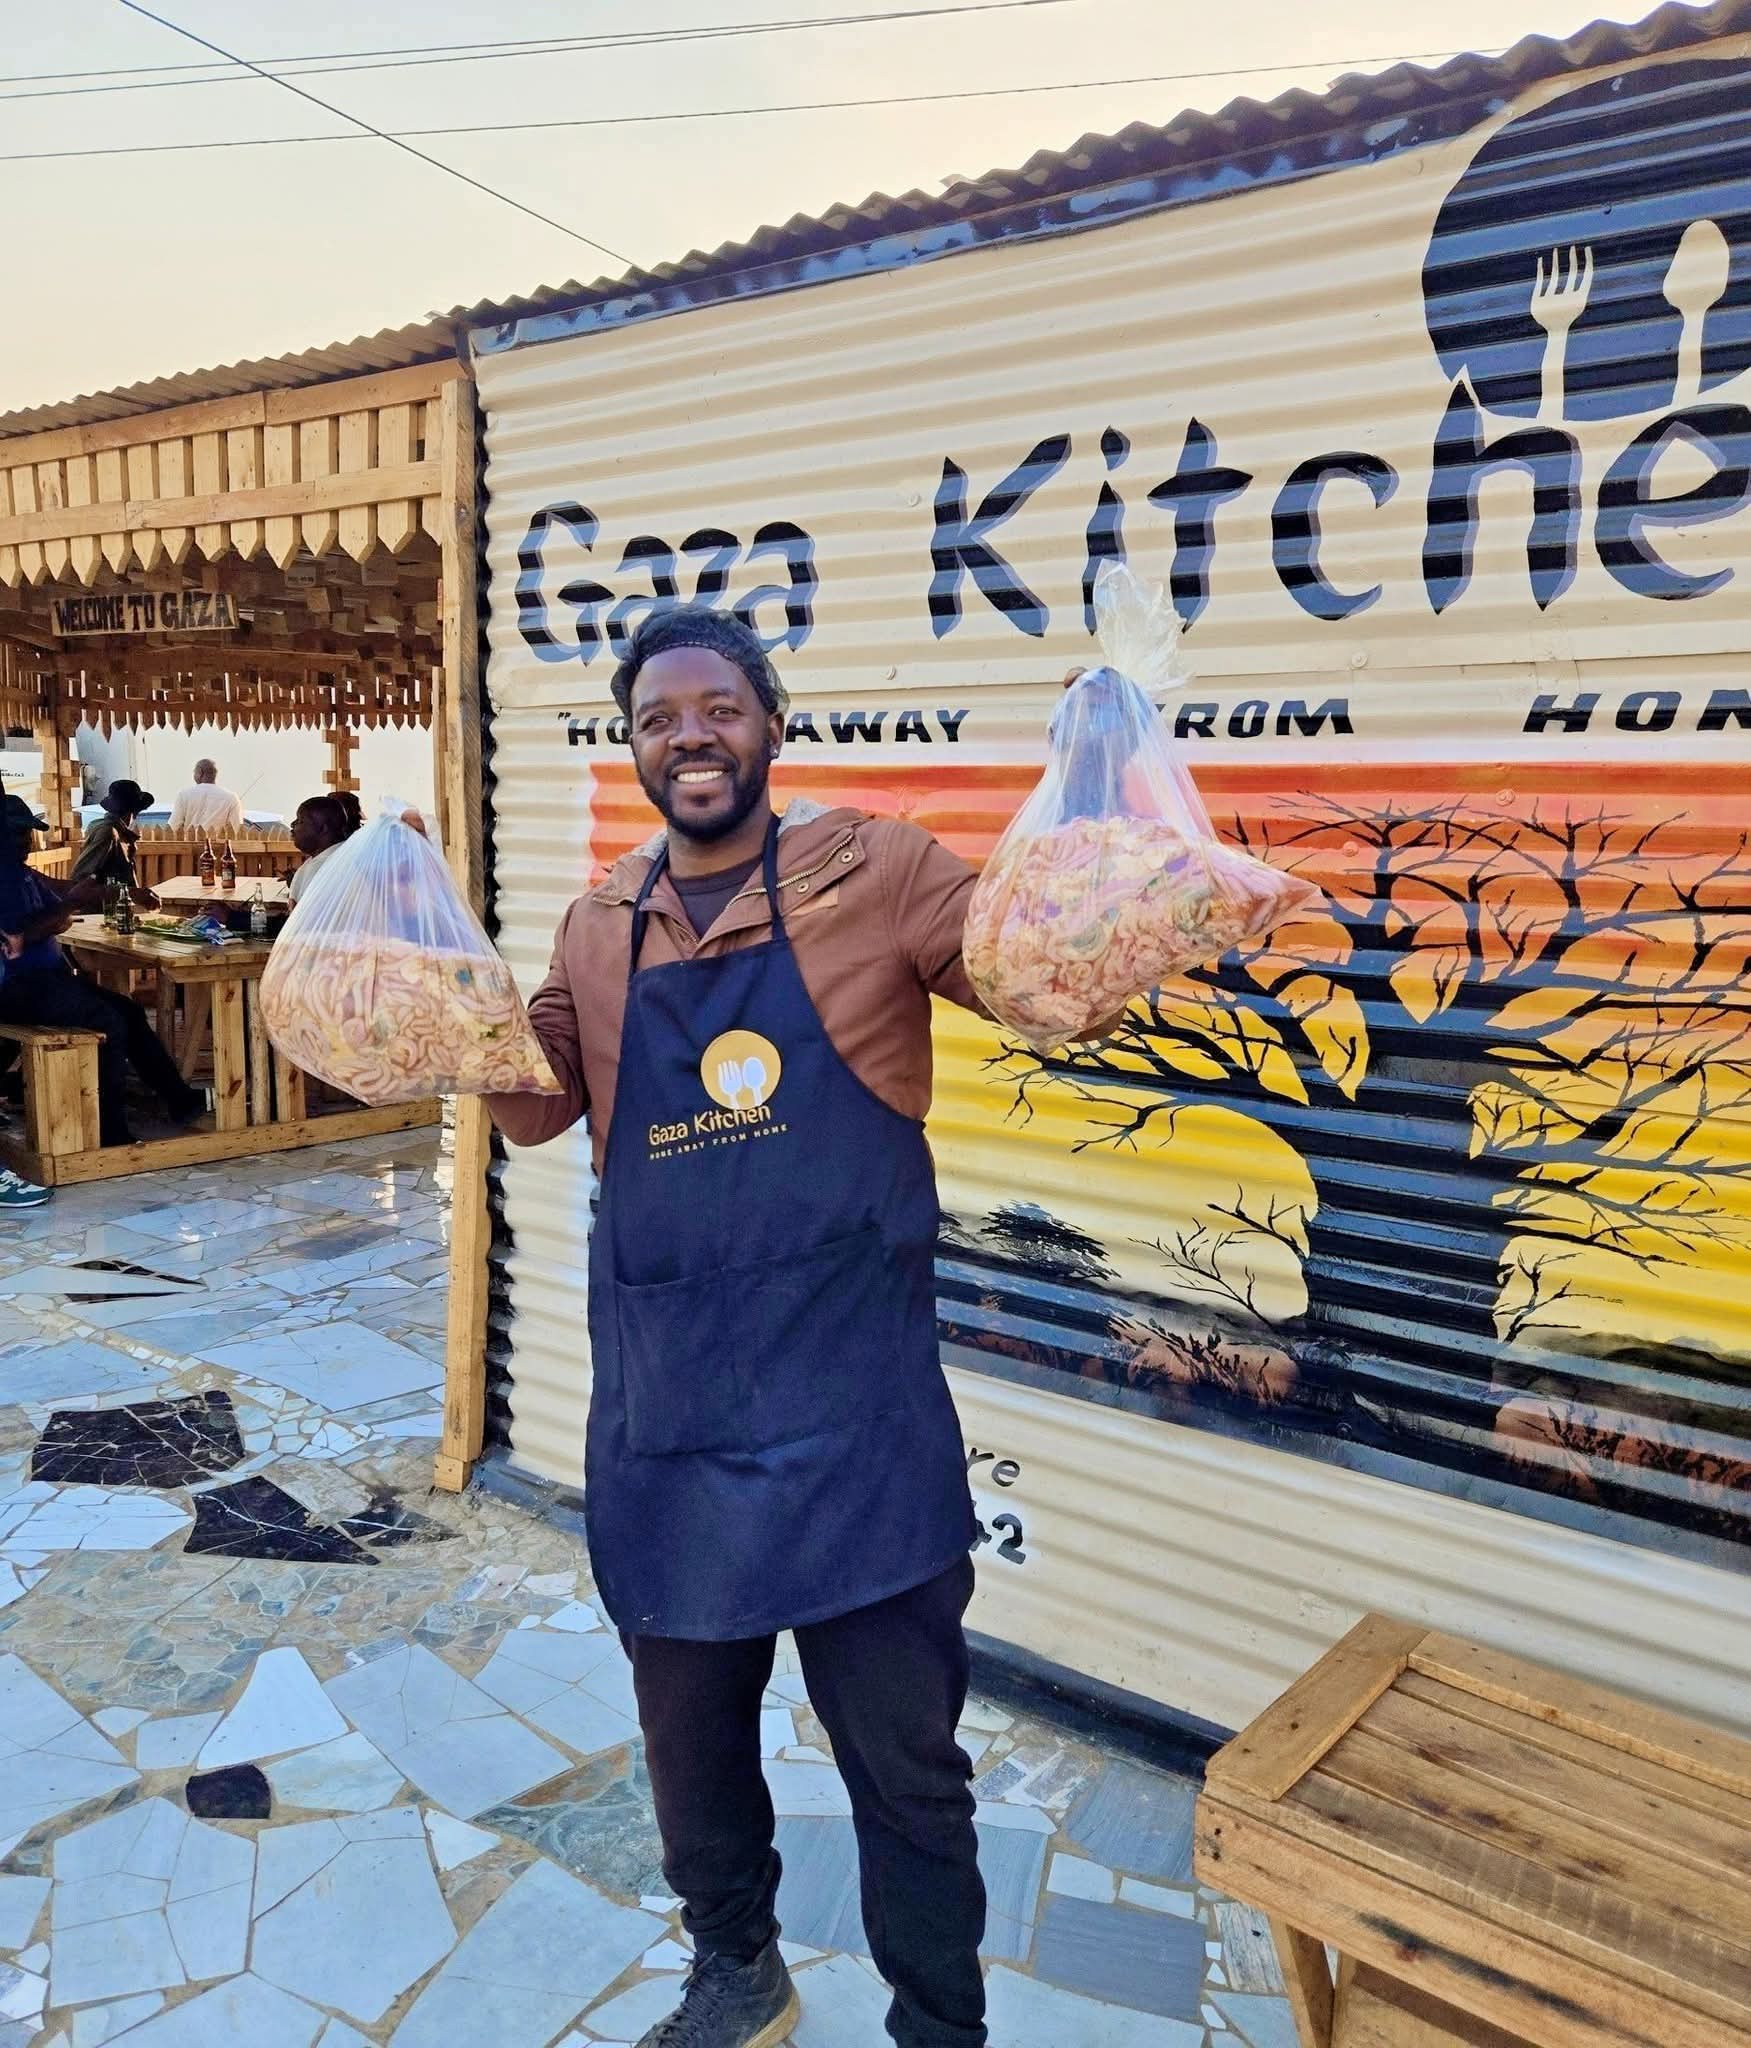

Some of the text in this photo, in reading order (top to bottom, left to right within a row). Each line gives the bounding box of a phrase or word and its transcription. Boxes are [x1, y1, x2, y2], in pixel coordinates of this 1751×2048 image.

[514, 501, 819, 667] Gaza
[53, 591, 236, 634] WELCOME TO GAZA
[558, 711, 633, 746] "HO
[784, 709, 970, 743] AWAY
[1155, 698, 1354, 738] ROM
[648, 1104, 771, 1146] Gaza Kitchen
[677, 1140, 705, 1154] AWAY
[712, 1132, 747, 1146] FROM
[753, 1123, 787, 1138] HOME
